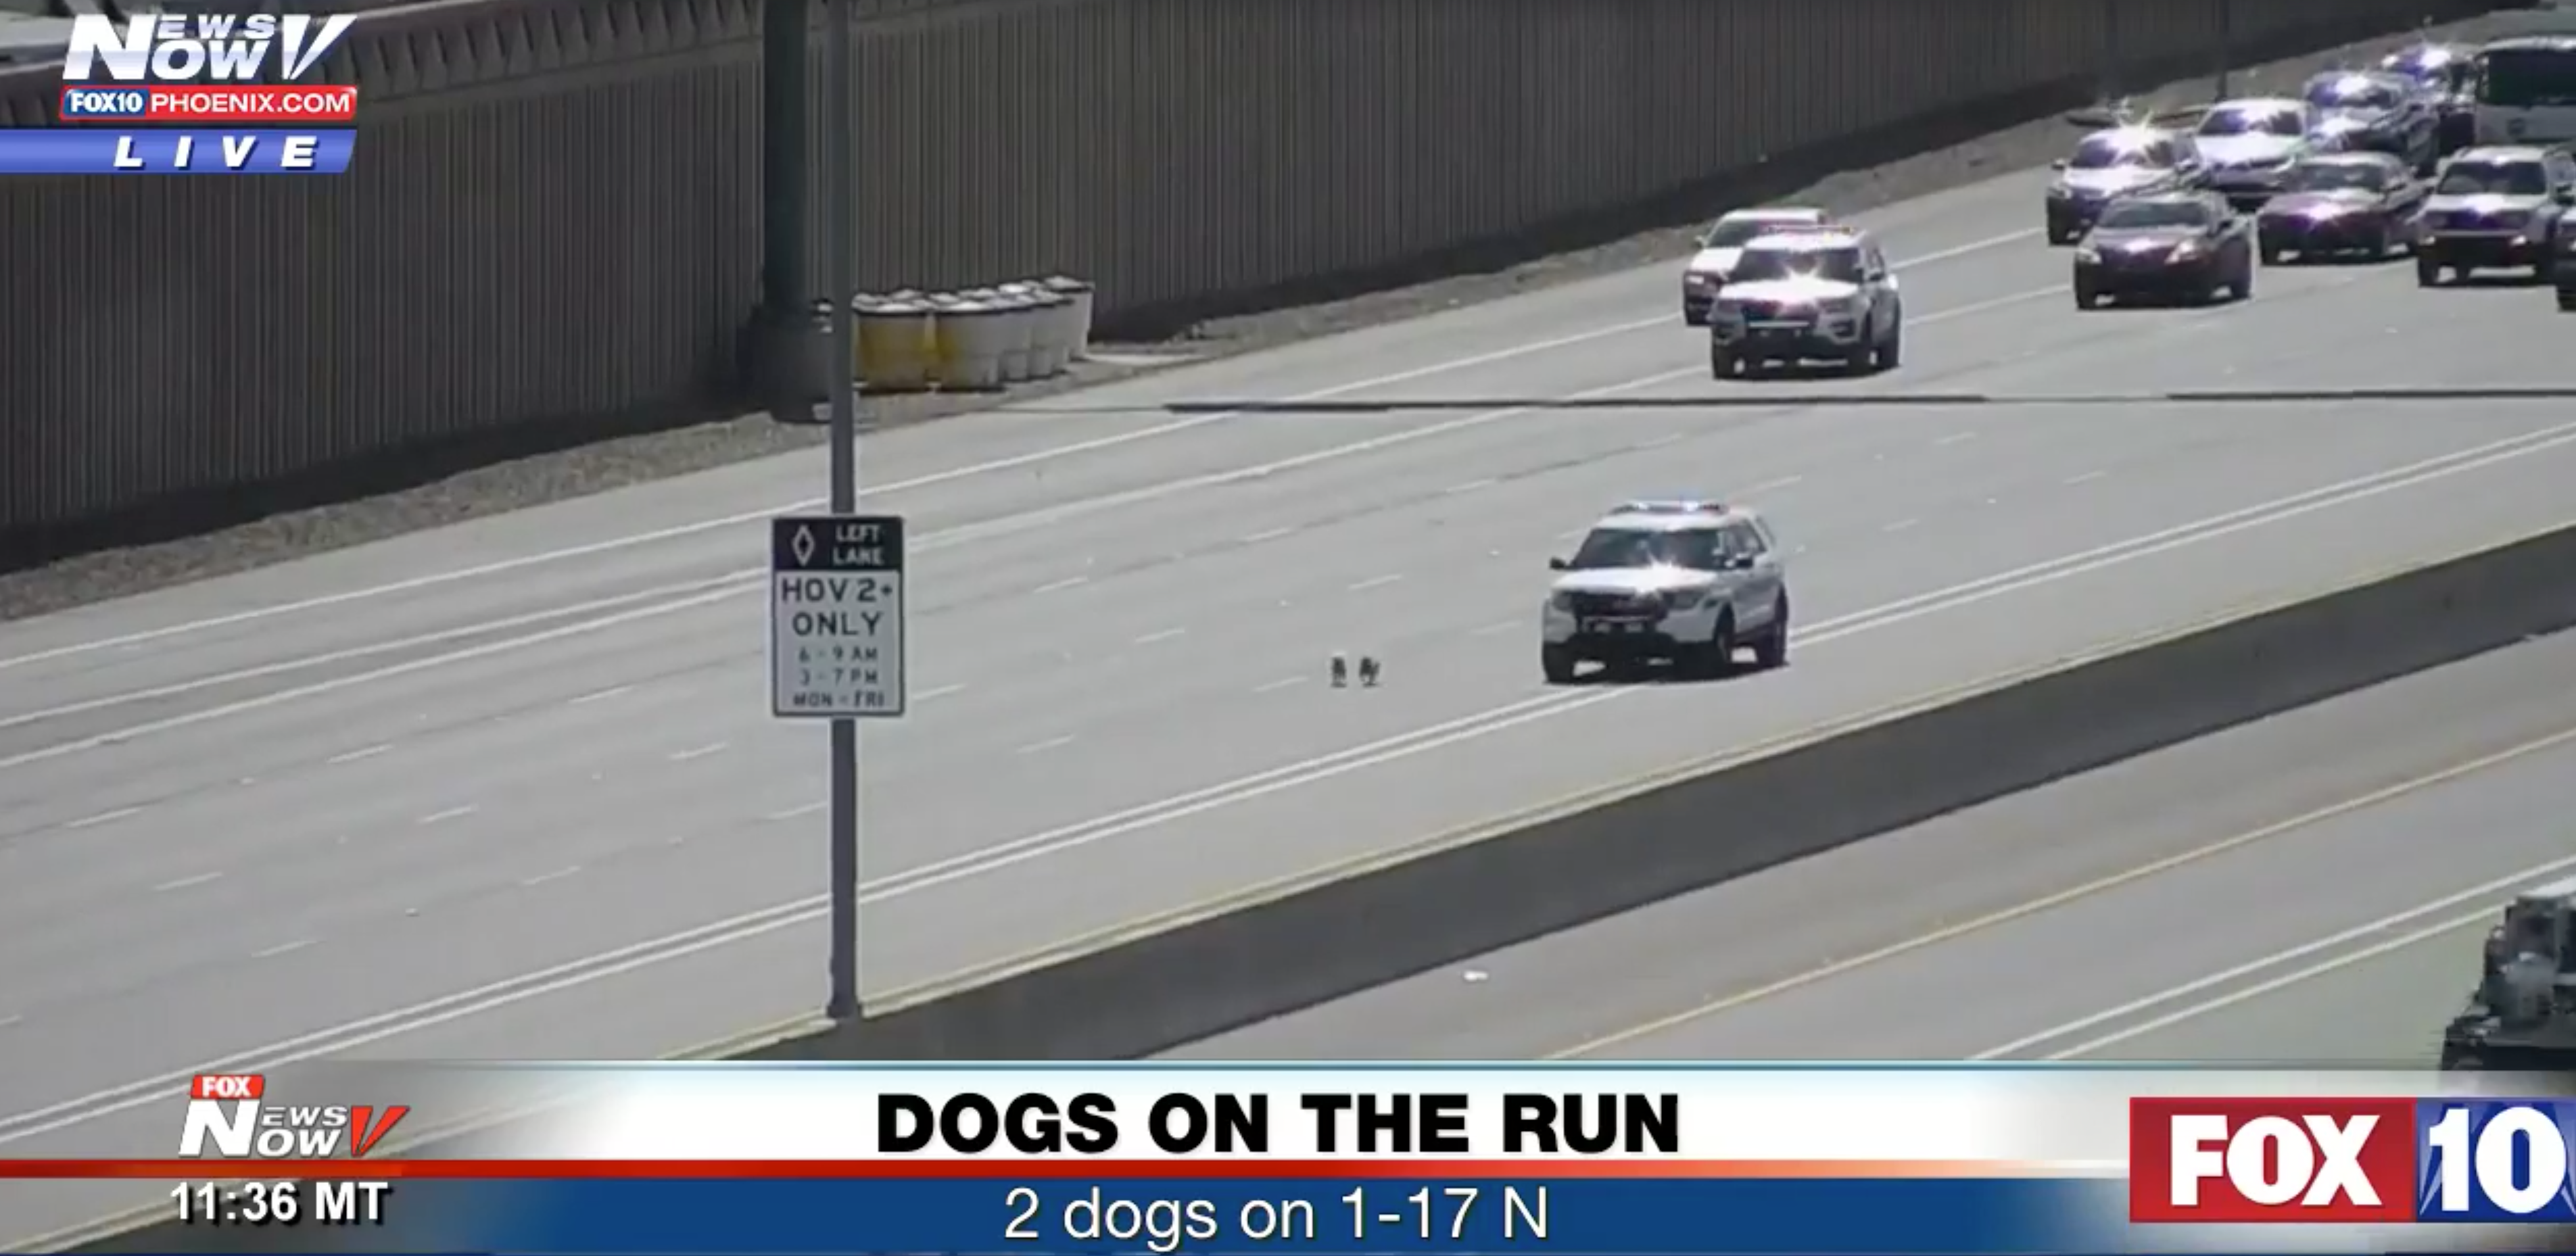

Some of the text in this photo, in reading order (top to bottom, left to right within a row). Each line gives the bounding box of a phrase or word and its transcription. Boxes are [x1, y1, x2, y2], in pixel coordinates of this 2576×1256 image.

[835, 523, 880, 543] LEFT
[833, 546, 884, 566] LANE
[782, 577, 893, 603] HOV 2+
[792, 611, 884, 637] ONLY
[851, 646, 878, 662] AM
[851, 668, 878, 685] PM
[793, 692, 833, 707] MON
[854, 690, 885, 707] FRI
